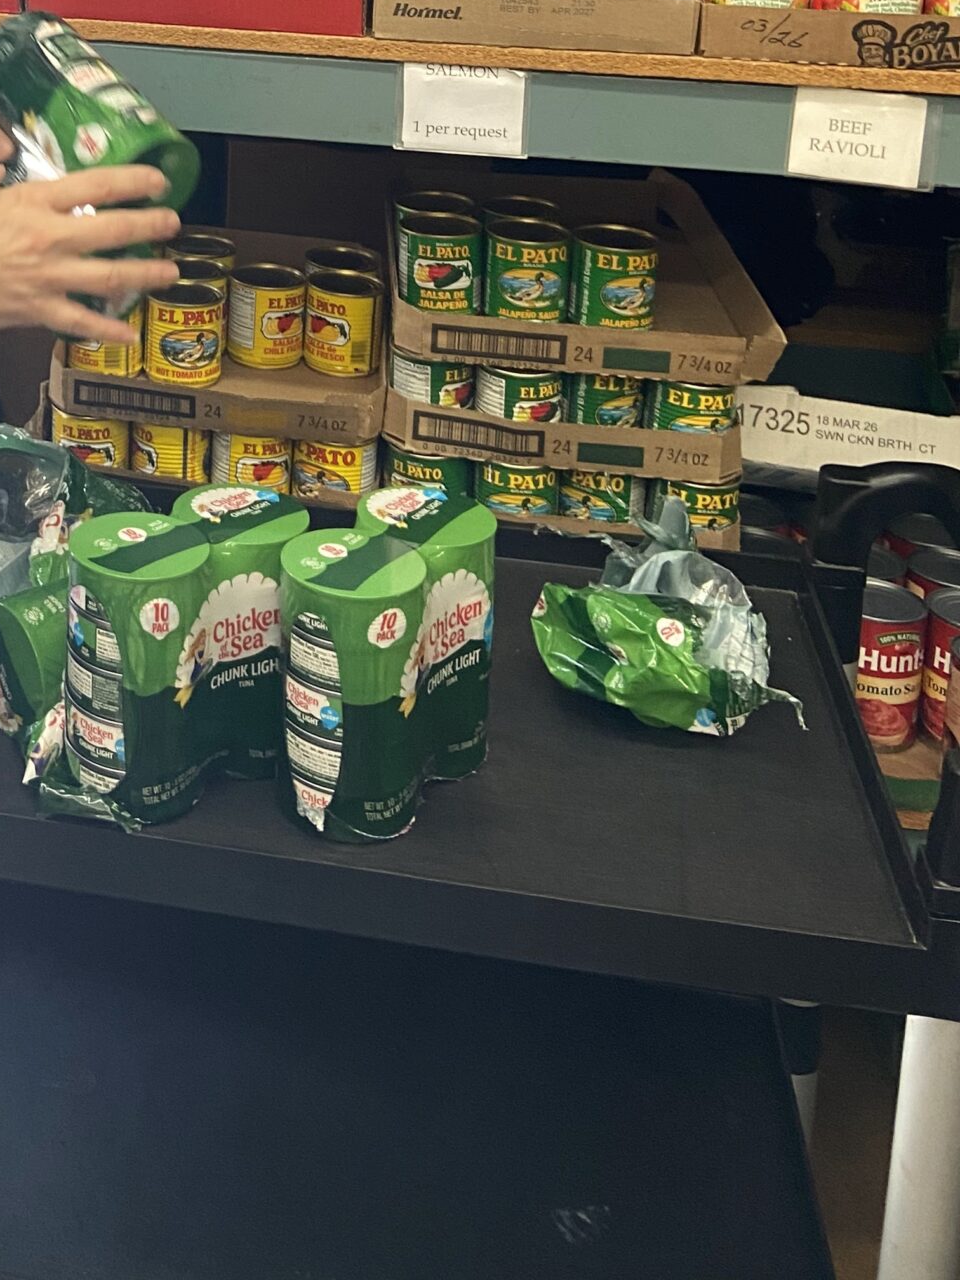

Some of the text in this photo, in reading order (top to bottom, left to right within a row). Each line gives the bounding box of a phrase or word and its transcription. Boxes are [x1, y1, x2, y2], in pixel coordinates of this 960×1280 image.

[500, 4, 524, 13] BEST
[525, 5, 541, 14] BY
[551, 7, 571, 15] APR
[906, 25, 945, 46] Chef
[425, 63, 499, 79] SALMON
[412, 121, 508, 140] 1 per request
[829, 118, 873, 136] BEEF
[808, 137, 887, 160] RAVIOLI
[418, 245, 470, 259] EL PATO
[495, 243, 567, 264] EL PATO
[268, 297, 284, 309] EL
[418, 298, 468, 310] JALAPEÑO
[420, 290, 466, 300] SALSA DE
[157, 306, 222, 327] EL PATO
[316, 299, 347, 316] PATO
[497, 308, 537, 319] JALAPEÑO
[599, 317, 639, 328] JALAPEÑO
[316, 349, 345, 363] FRESCO
[573, 345, 733, 375] 24 7 3/4 OZ
[155, 367, 170, 377] HOT
[171, 369, 203, 379] TOMATO
[520, 386, 535, 399] EL
[203, 404, 348, 432] 24 7 3/4 OZ
[736, 402, 811, 437] 17325
[816, 414, 879, 433] 18 MAR 26
[62, 425, 111, 440] EL PATO
[815, 429, 937, 455] SWN CKN BRTH CT
[243, 442, 259, 455] EL
[305, 444, 356, 467] PATO
[552, 439, 710, 466] 24 7 3/4 OZ
[393, 459, 442, 481] EL PATO
[507, 471, 556, 490] PATO
[695, 489, 740, 510] PATO
[153, 602, 170, 622] 10
[380, 611, 397, 631] 10
[151, 621, 171, 634] PACK
[429, 600, 483, 646] Chicken
[376, 628, 396, 643] PACK
[440, 628, 466, 657] Sea
[230, 629, 267, 662] Sea
[210, 663, 249, 690] CHUNK
[426, 648, 482, 695] CHUNK LIGHT
[288, 680, 320, 707] Chicken
[856, 683, 902, 697] omato
[80, 718, 114, 741] Chicken
